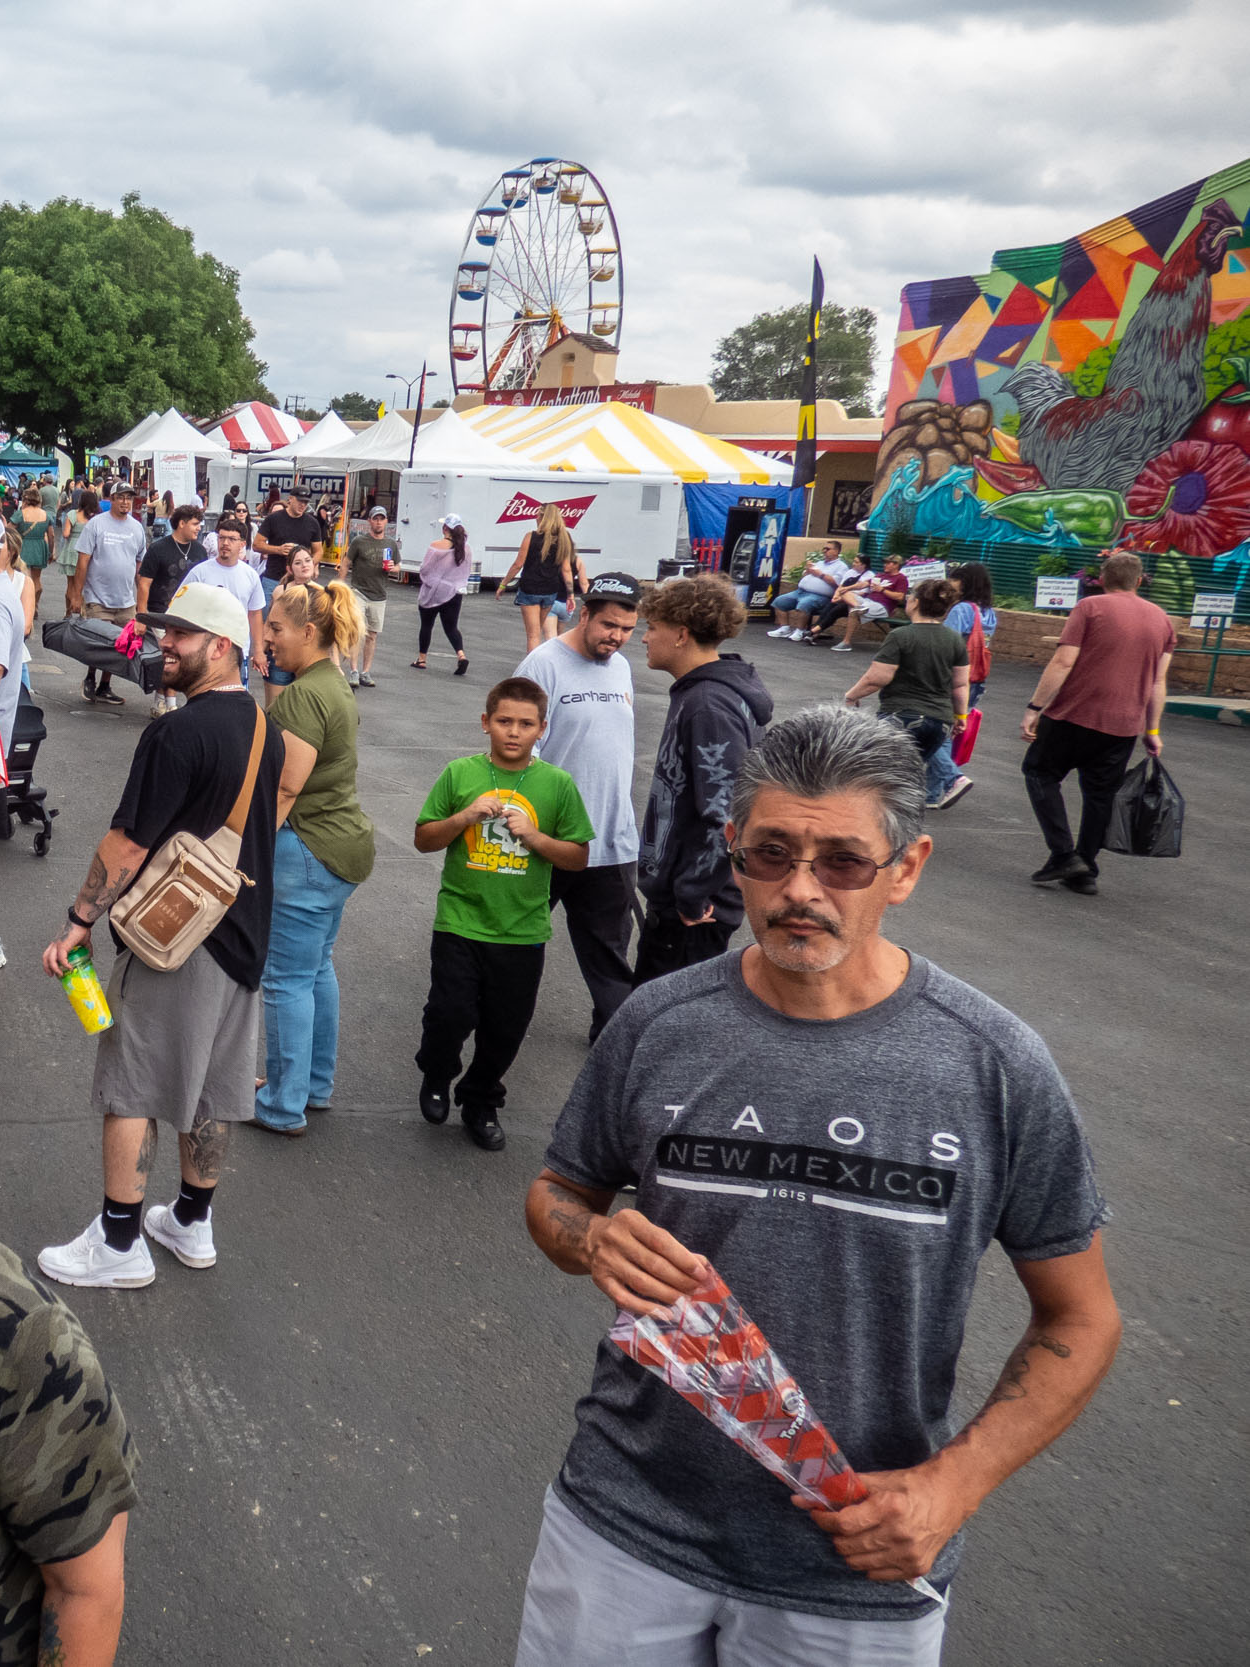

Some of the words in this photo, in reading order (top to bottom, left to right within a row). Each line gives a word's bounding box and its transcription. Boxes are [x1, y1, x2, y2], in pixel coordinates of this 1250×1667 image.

[260, 476, 293, 490] BUD
[740, 498, 767, 507] ATM
[758, 518, 778, 578] ATM
[590, 578, 635, 595] Raiders
[559, 690, 625, 705] carhartt
[476, 838, 503, 855] los
[469, 849, 529, 871] angeles
[497, 867, 527, 876] california
[667, 1140, 750, 1171] NEW
[767, 1150, 944, 1201] MEXICO
[771, 1187, 807, 1201] 1615
